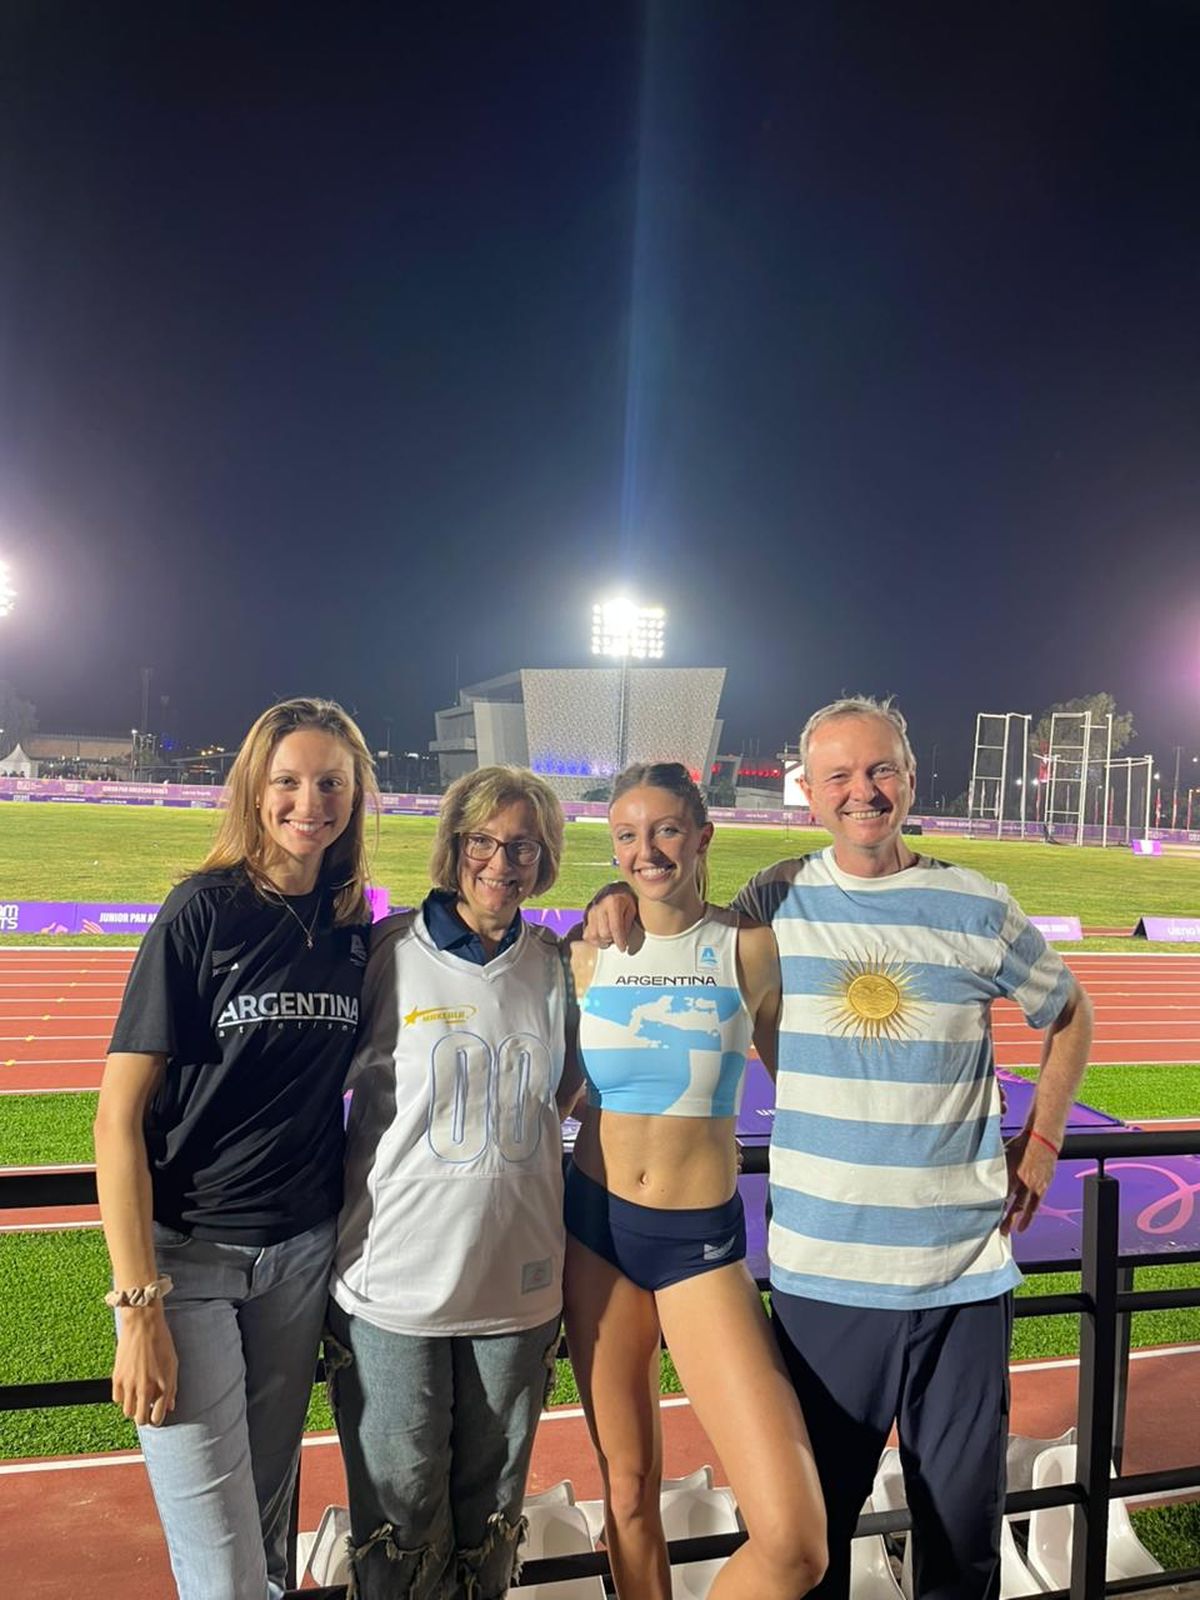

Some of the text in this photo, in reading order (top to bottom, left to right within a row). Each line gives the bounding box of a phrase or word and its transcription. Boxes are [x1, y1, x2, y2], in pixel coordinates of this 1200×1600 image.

[99, 912, 129, 922] JUNIOR
[129, 912, 147, 923] PAN
[615, 975, 717, 986] ARGENTINA
[217, 991, 359, 1024] ARGENTINA
[428, 1030, 552, 1163] 00
